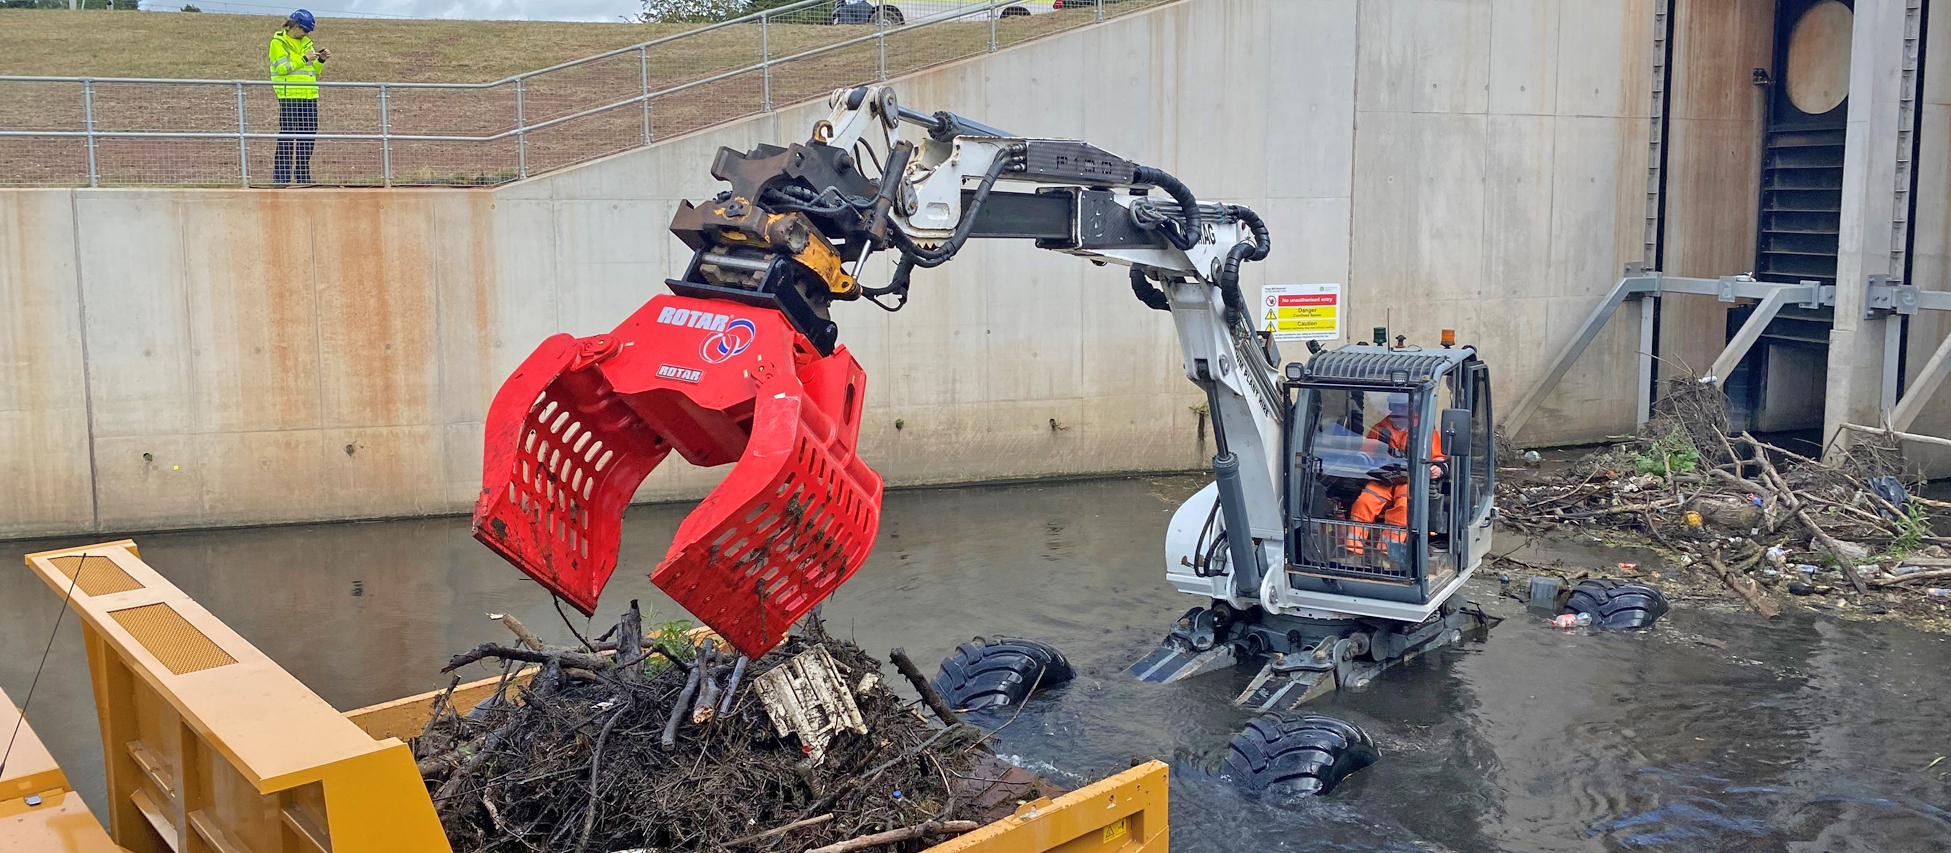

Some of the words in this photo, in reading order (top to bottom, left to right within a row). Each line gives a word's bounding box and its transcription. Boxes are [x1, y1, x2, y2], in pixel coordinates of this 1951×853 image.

[657, 306, 729, 333] ROTAR
[658, 365, 701, 381] ROTAR
[1243, 369, 1259, 397] PLANT
[1258, 396, 1270, 418] HIRE
